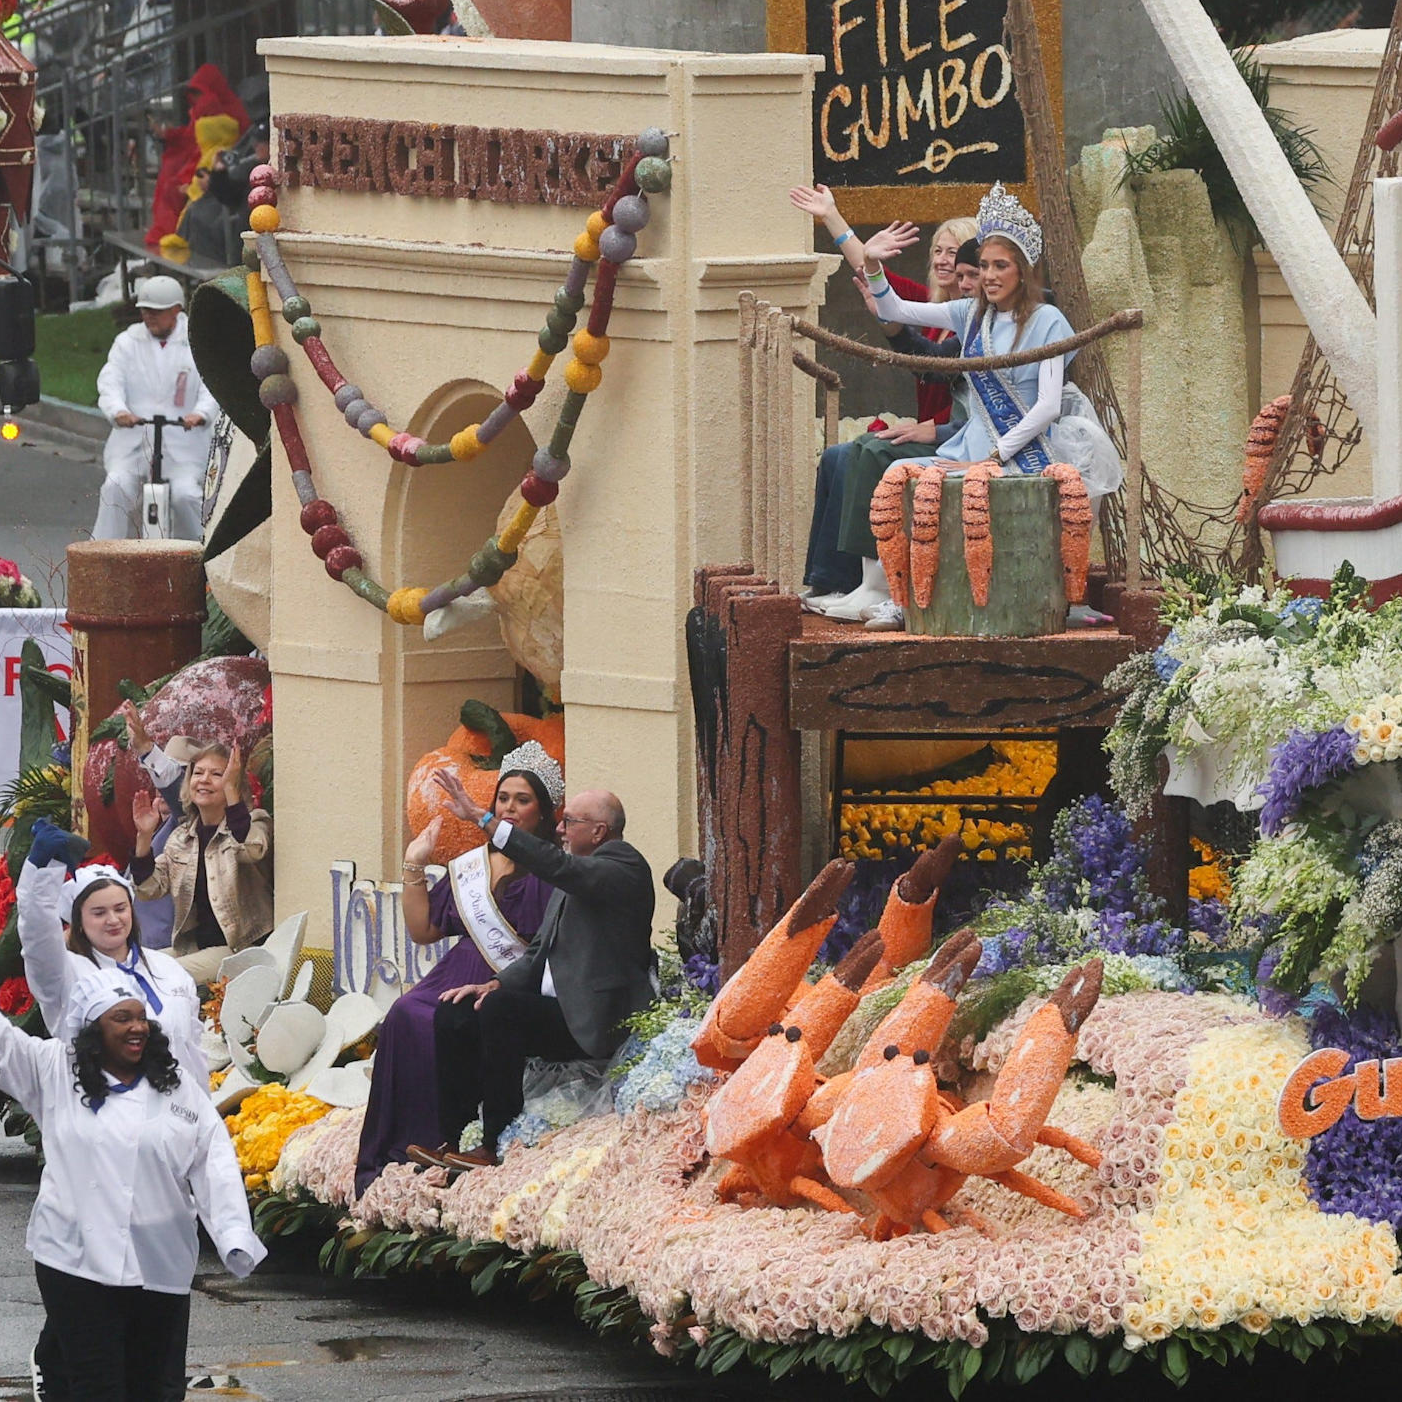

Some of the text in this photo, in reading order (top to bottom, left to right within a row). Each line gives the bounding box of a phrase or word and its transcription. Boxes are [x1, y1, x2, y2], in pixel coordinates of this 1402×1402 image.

[820, 44, 1012, 162] GUMBO
[273, 112, 456, 198] FRENCH
[977, 370, 1007, 412] nzales
[486, 927, 516, 962] Oyster
